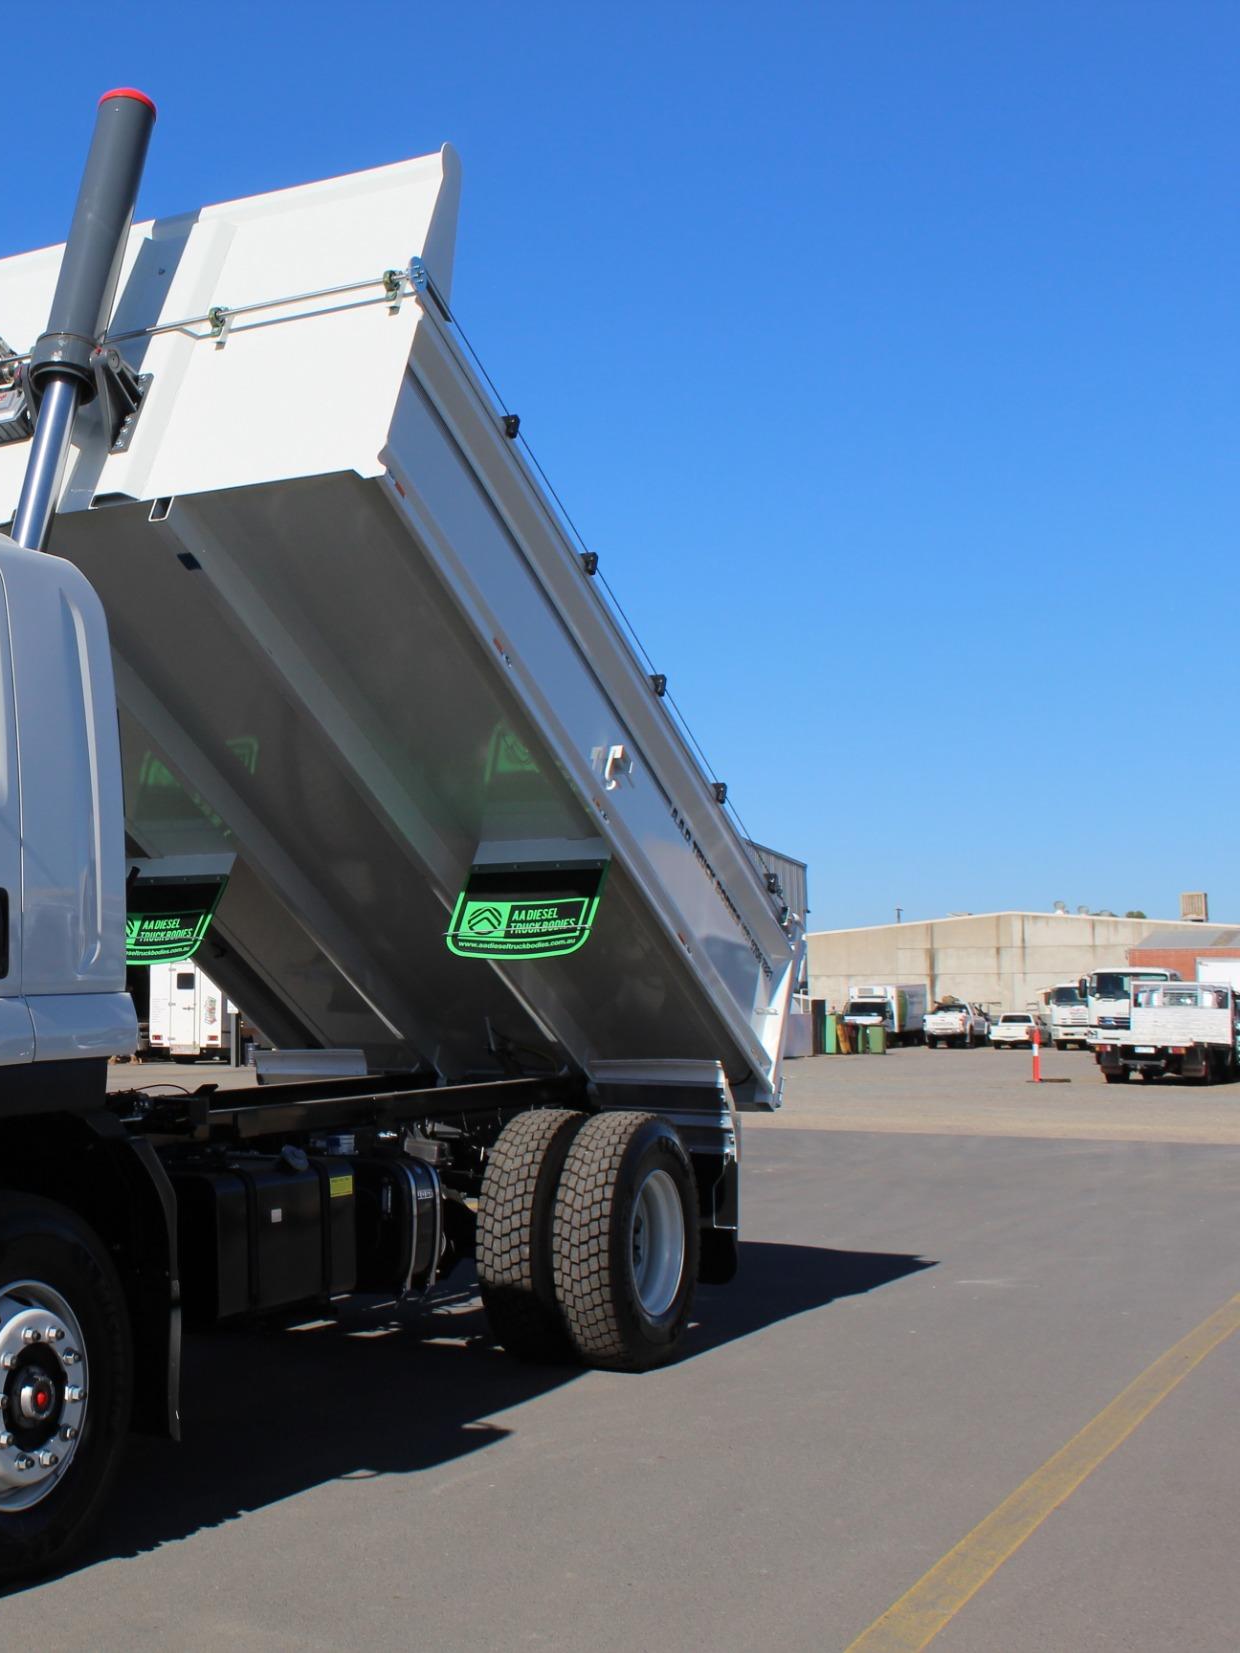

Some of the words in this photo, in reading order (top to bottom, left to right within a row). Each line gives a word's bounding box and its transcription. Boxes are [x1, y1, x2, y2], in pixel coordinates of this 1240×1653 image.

[509, 922, 542, 935] TRUCK
[541, 918, 576, 932] BODIES
[140, 931, 166, 942] TRUCK
[166, 928, 194, 940] BODIES
[458, 938, 576, 950] www.aadieseltruckbodies.com.au
